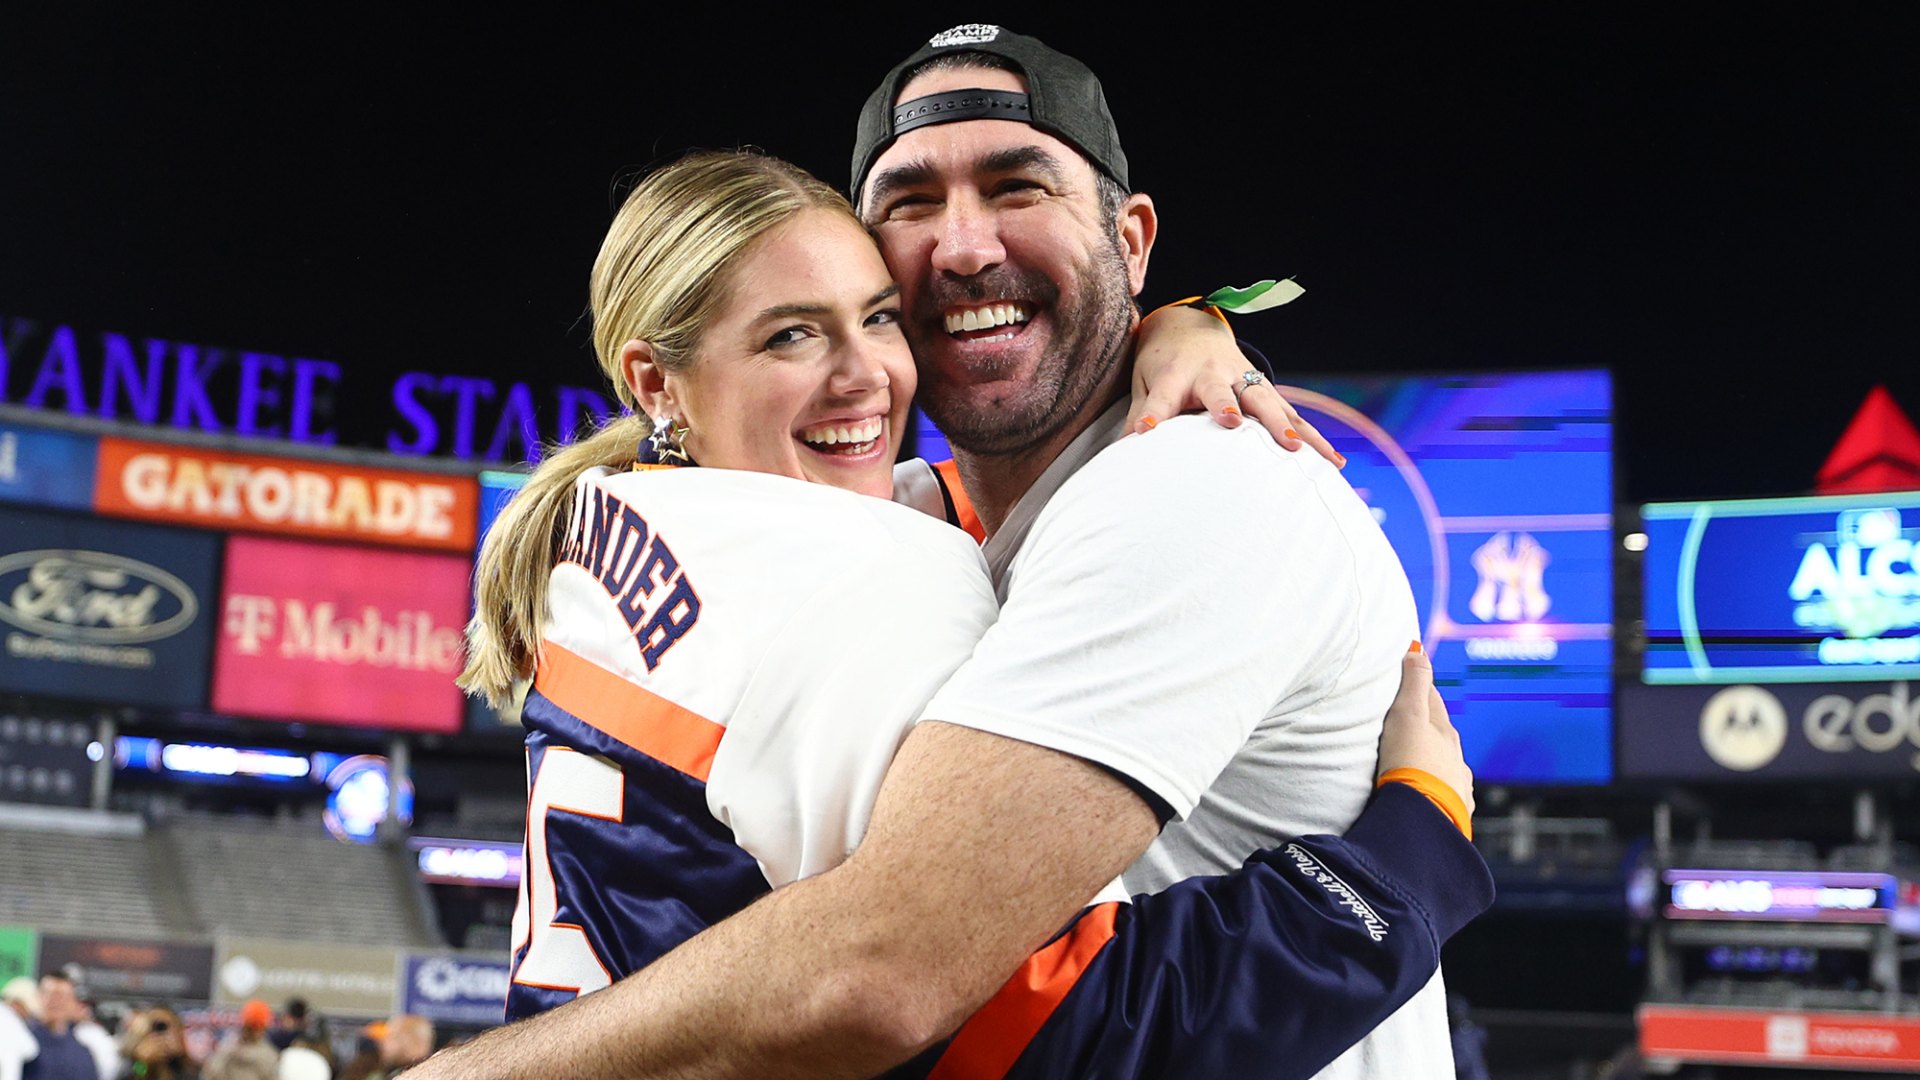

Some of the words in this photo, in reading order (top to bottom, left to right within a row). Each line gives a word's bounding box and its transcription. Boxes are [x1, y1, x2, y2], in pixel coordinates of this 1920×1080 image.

[387, 371, 633, 468] STAD
[121, 452, 455, 540] GATORADE
[12, 557, 161, 628] Ford
[1788, 539, 1920, 601] ALC
[1803, 680, 1920, 772] ed
[1322, 881, 1388, 942] Mitchell
